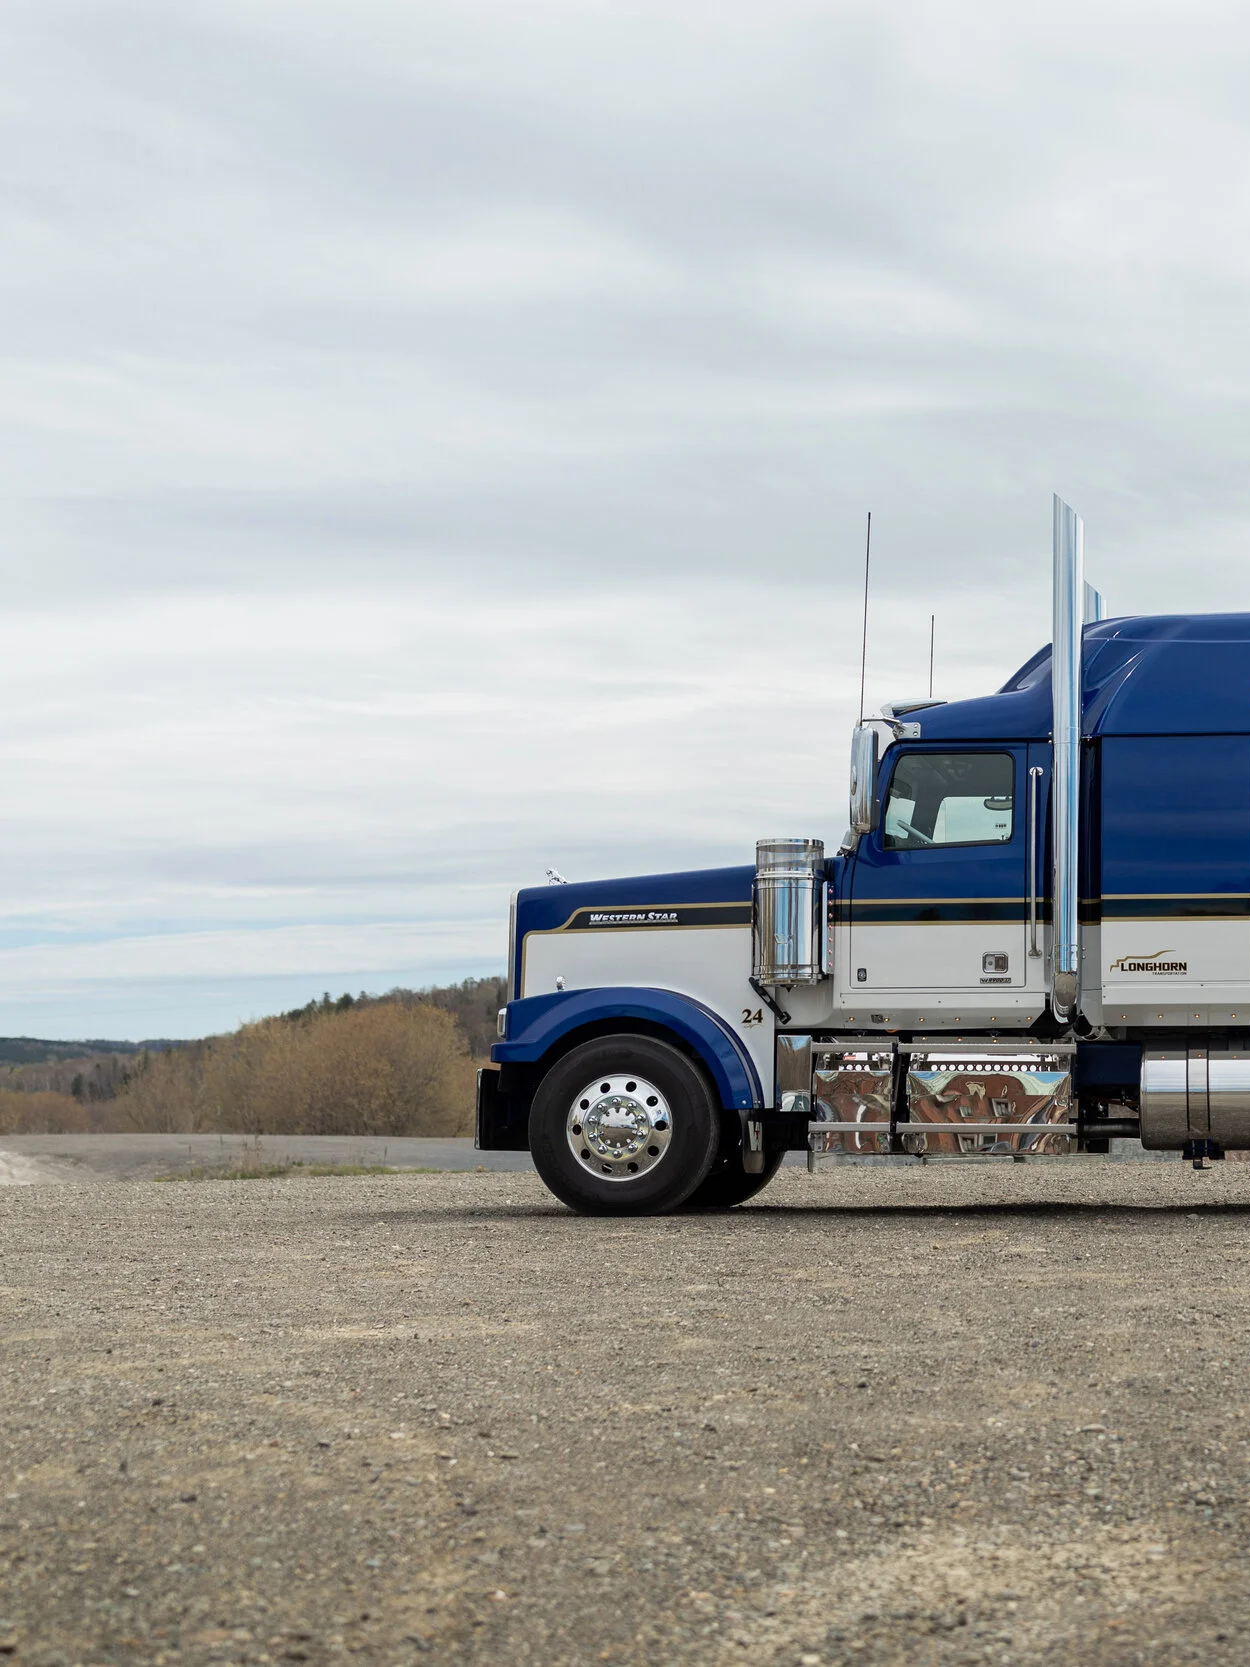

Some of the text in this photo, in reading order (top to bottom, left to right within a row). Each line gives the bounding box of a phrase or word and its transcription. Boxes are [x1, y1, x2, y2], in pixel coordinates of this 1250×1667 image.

[590, 911, 678, 922] WESTERN STAR
[1120, 962, 1187, 972] LONGHORN
[741, 1008, 763, 1024] 24
